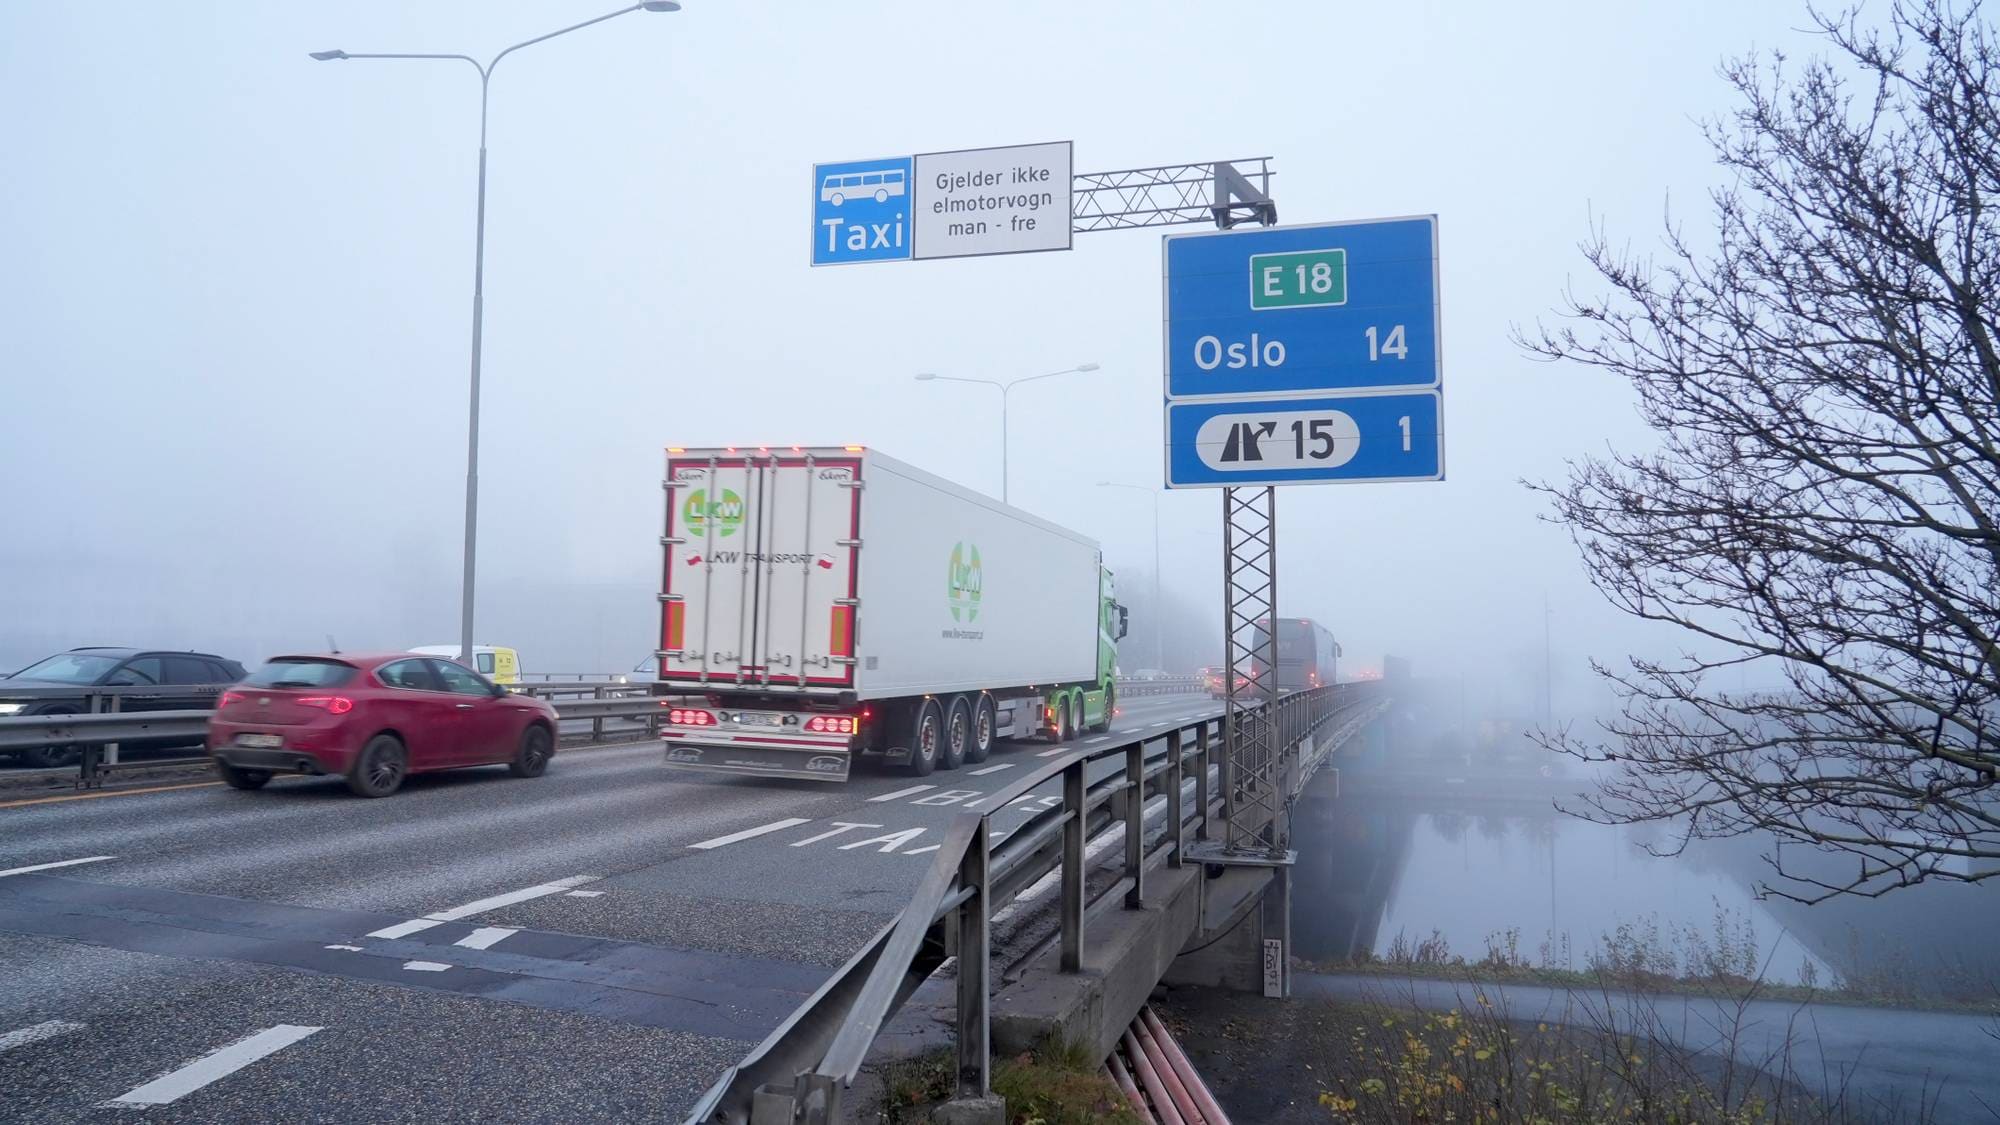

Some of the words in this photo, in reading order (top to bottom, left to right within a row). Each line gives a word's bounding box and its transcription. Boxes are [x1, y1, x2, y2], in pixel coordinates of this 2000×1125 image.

[936, 171, 1003, 193] Gjelder
[1012, 166, 1050, 184] ikke
[933, 192, 1052, 213] elmotorvogn
[822, 213, 903, 252] Taxi
[948, 220, 987, 236] man
[1010, 215, 1037, 232] fre
[1264, 266, 1283, 296] E
[1296, 262, 1333, 294] 18
[1194, 333, 1287, 370] Oslo
[1365, 325, 1409, 361] 14
[1291, 419, 1335, 460] 15
[1398, 415, 1412, 451] 1
[690, 502, 743, 519] LKW
[704, 552, 740, 564] LKW
[744, 553, 814, 565] TRANSPORT
[952, 561, 982, 593] LKW
